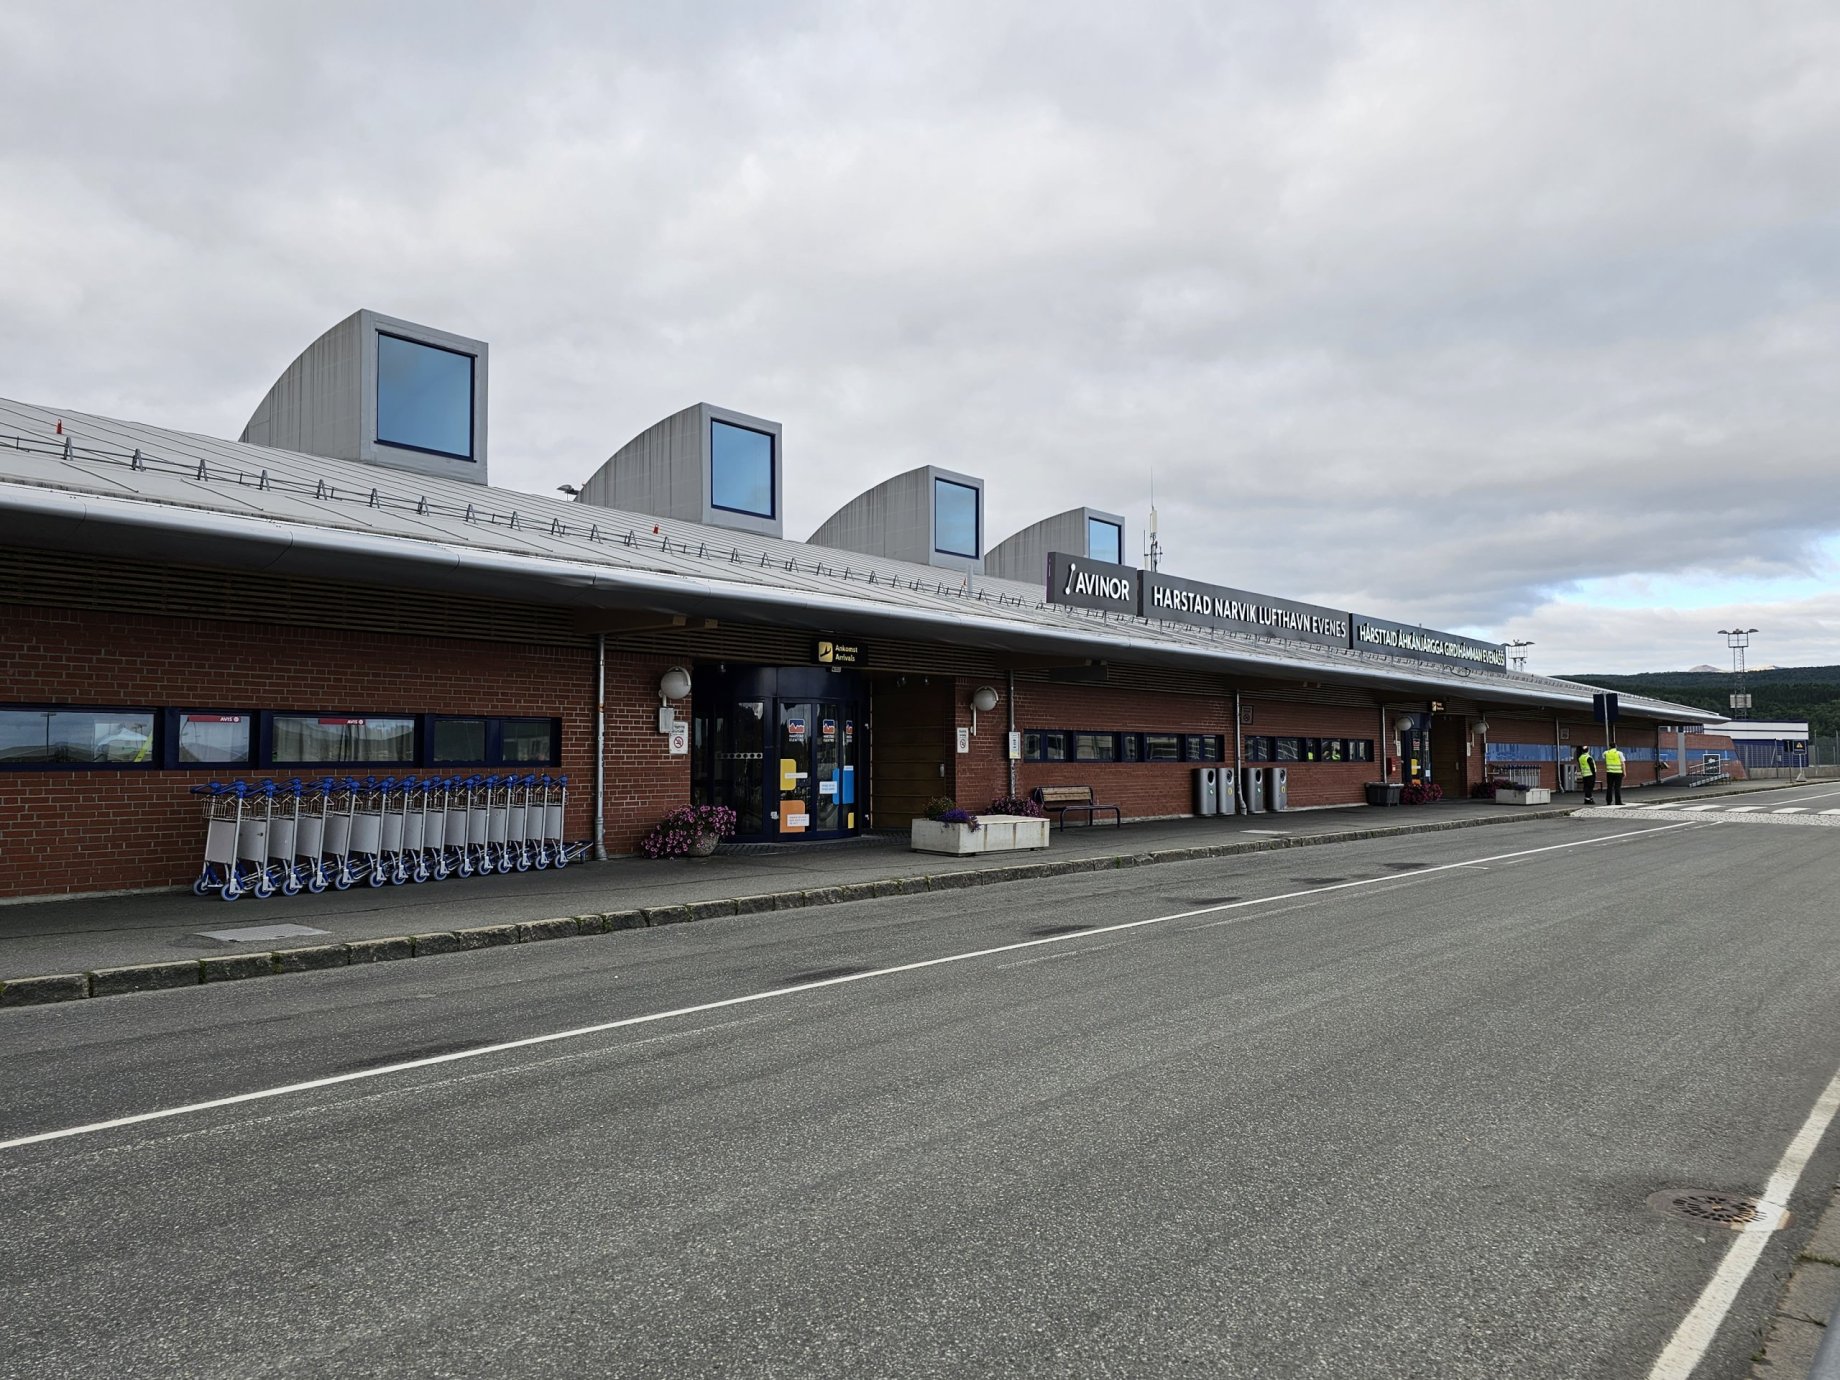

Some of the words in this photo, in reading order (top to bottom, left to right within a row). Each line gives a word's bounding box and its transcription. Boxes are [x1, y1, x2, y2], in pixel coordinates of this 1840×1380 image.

[1075, 571, 1130, 601] AVINOR
[1153, 585, 1212, 615] HARSTAD
[1214, 597, 1257, 623] NARVIK
[1259, 606, 1311, 633] LUFTHAVN
[1312, 616, 1347, 639] EVENES
[835, 644, 858, 654] Ankomst
[835, 653, 856, 662] Arrivals
